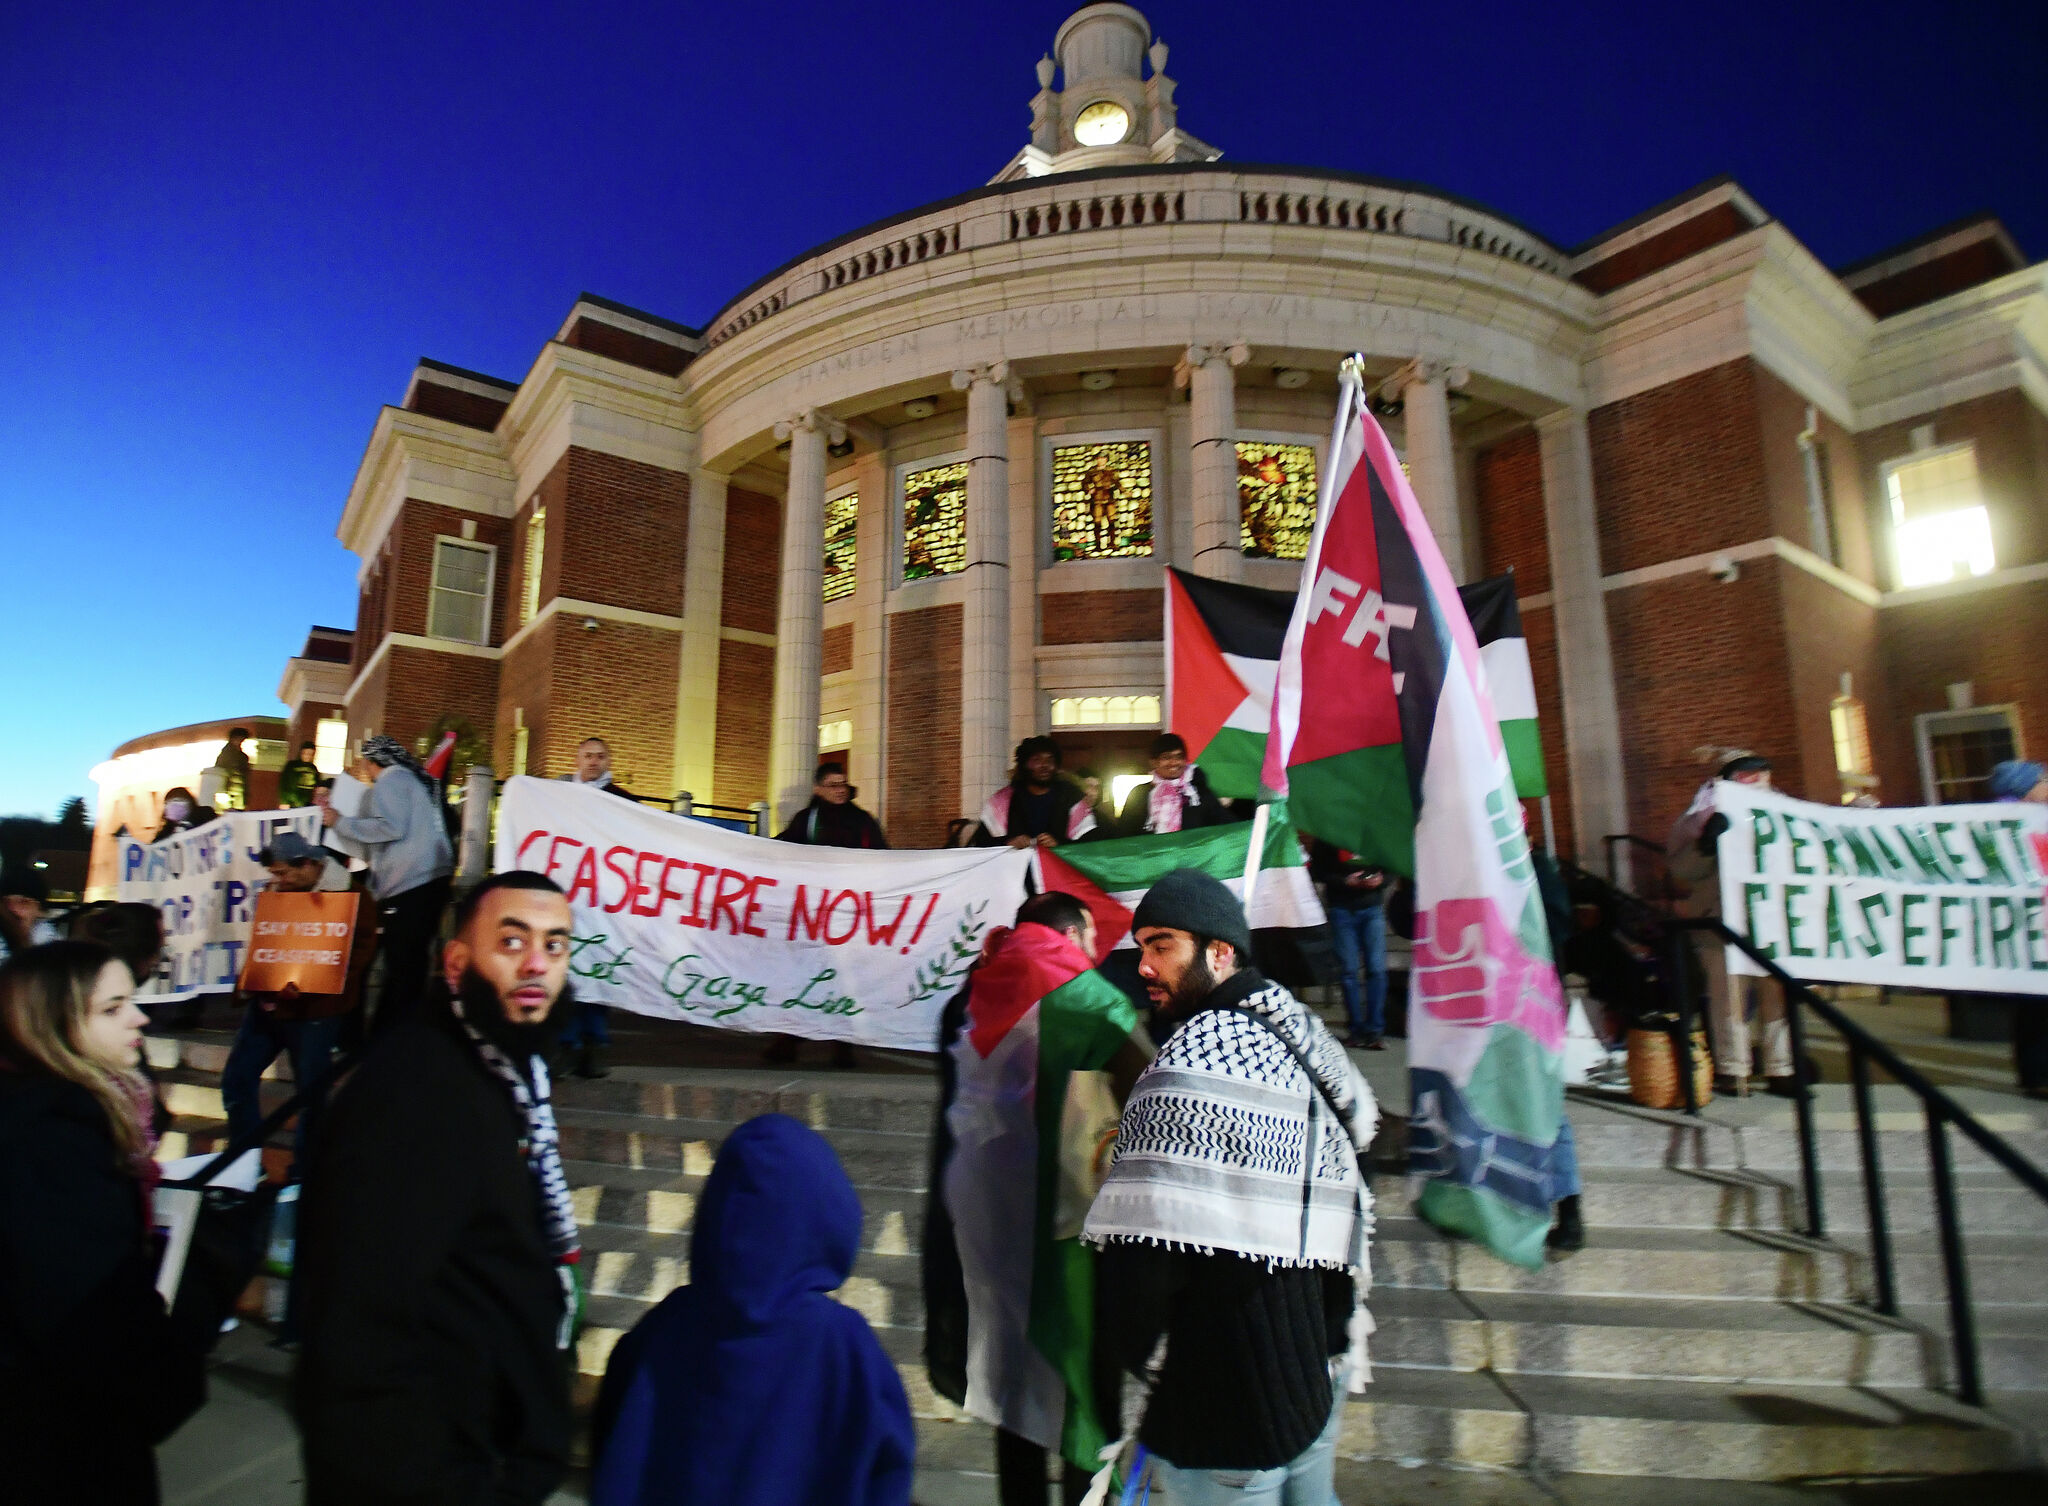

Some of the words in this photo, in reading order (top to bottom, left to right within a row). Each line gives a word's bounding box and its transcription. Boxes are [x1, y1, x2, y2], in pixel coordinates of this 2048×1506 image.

[956, 299, 1162, 341] MEMORIAL
[254, 920, 289, 936] SAY
[291, 921, 322, 937] YES
[324, 922, 348, 937] TO
[786, 884, 941, 955] NOW!
[1745, 882, 2048, 971] CEASEFIRE
[253, 948, 342, 965] CEASEFIRE
[567, 933, 634, 985] Let
[662, 954, 768, 1018] Gaza
[780, 968, 865, 1016] Live
